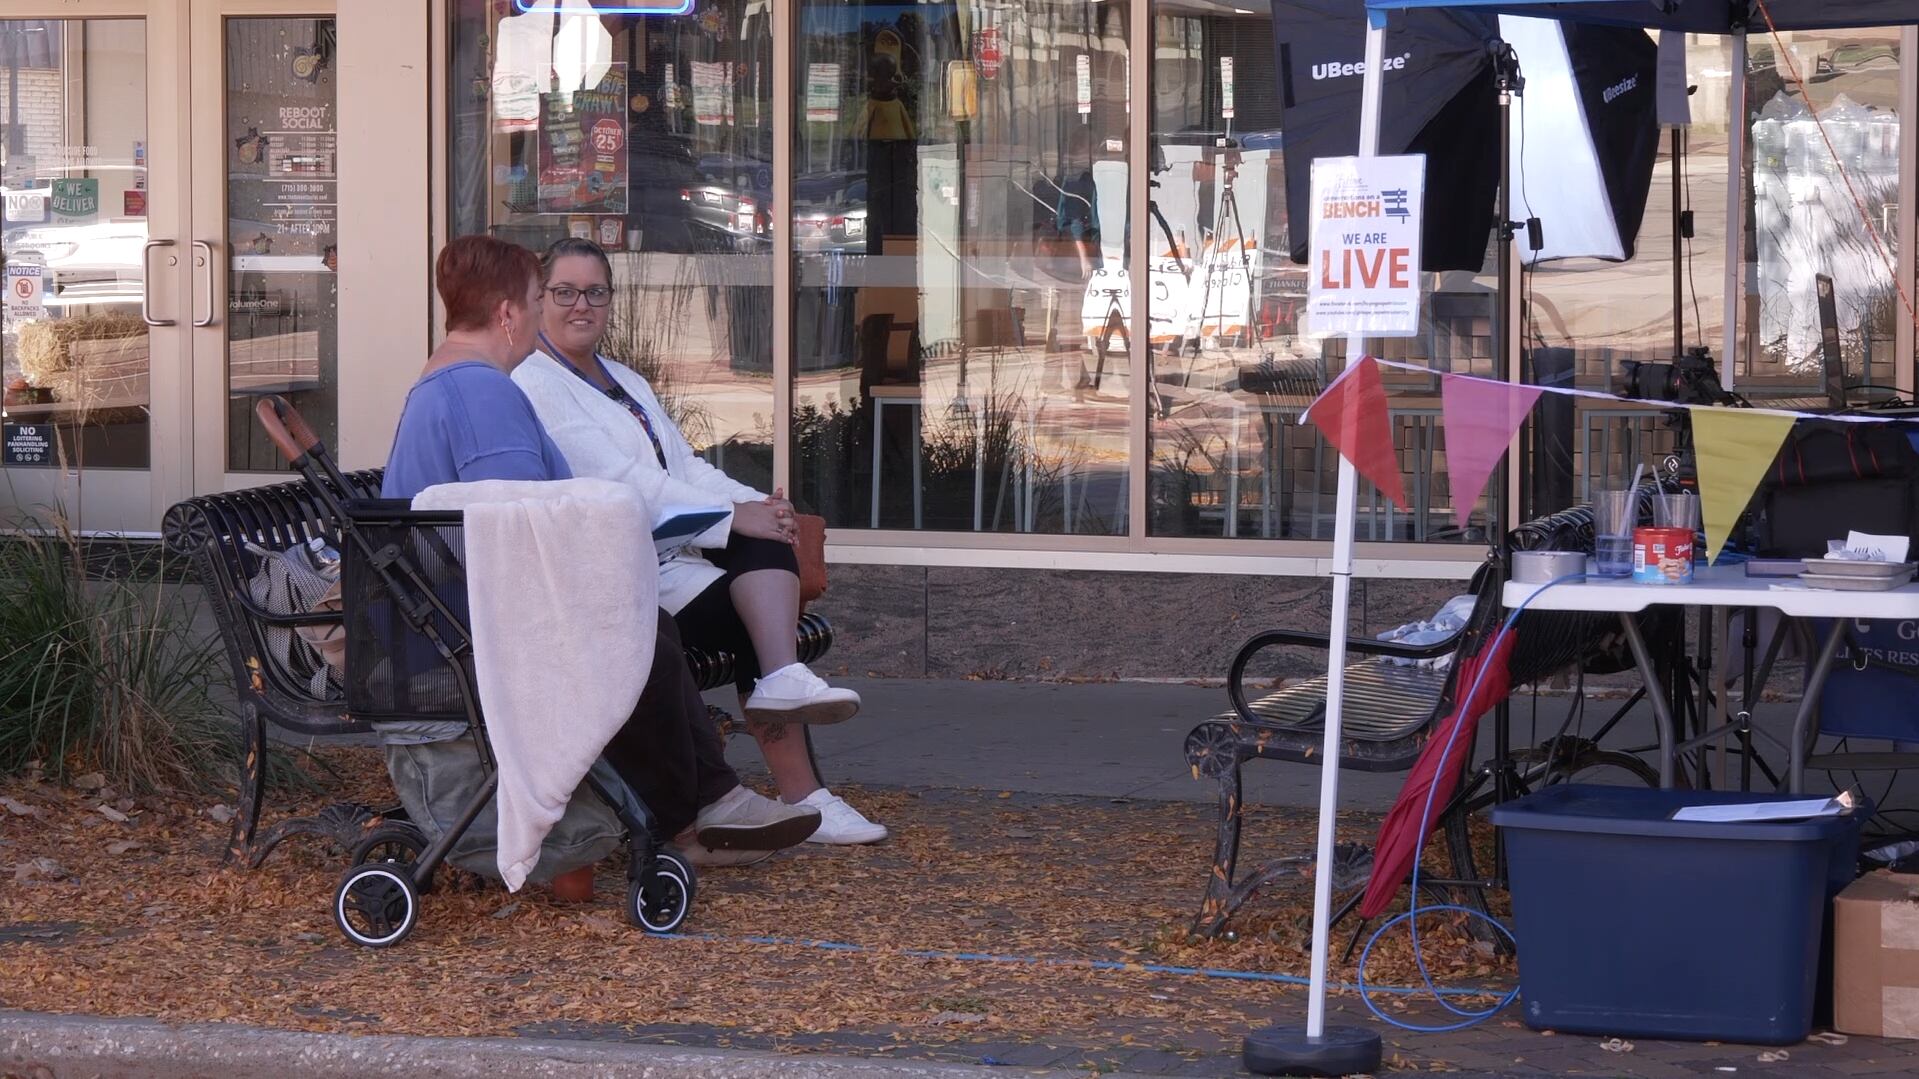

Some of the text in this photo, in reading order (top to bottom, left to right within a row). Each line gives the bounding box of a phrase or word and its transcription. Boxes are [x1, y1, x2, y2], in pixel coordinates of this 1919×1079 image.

[1312, 55, 1406, 80] UBeeze
[280, 107, 326, 118] REBOOT
[282, 119, 323, 129] SOCIAL
[597, 134, 616, 150] 25
[66, 184, 83, 196] WE
[8, 196, 28, 210] NO
[52, 197, 95, 213] DELIVER
[1323, 201, 1380, 219] BENCH
[290, 223, 310, 234] AFTER
[1342, 232, 1387, 245] WE ARE
[9, 266, 40, 276] NOTICE
[1322, 248, 1409, 289] LIVE
[20, 426, 36, 436] NO
[1897, 620, 1919, 640] G
